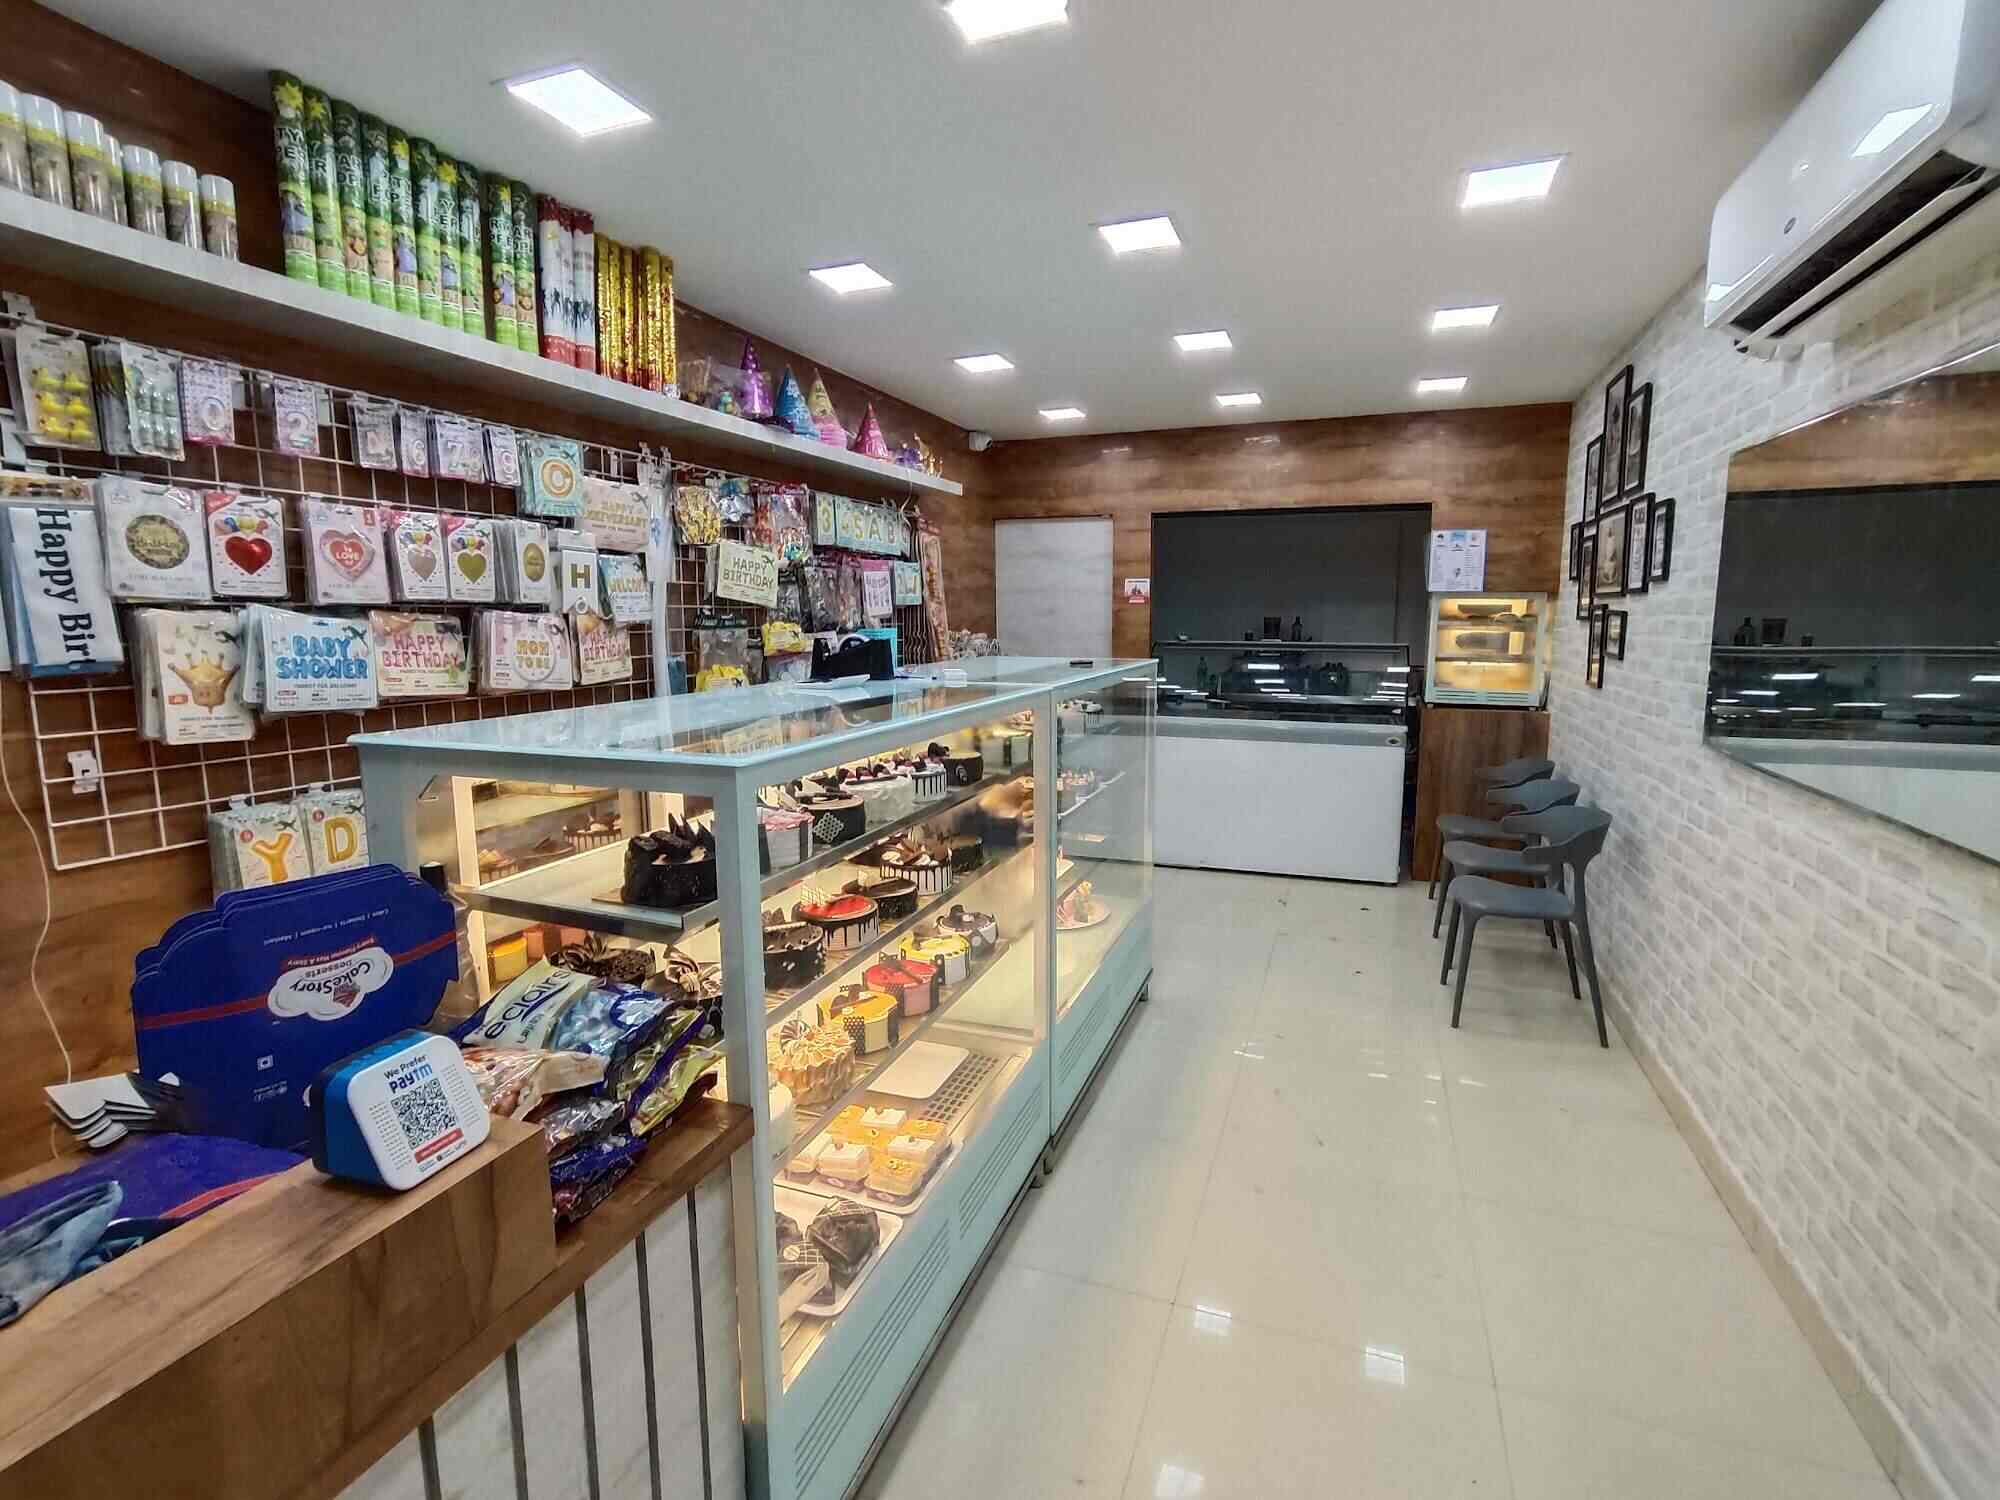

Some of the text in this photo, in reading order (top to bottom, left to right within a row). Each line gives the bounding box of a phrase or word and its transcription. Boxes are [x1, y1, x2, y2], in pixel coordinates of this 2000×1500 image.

[34, 508, 79, 604] Happy
[733, 557, 769, 575] HAPPY
[570, 563, 592, 589] H
[723, 568, 775, 589] BIRTHDAY
[292, 635, 353, 658] BABY
[393, 632, 447, 651] HAPPY
[276, 656, 369, 680] SHOWER
[382, 649, 460, 669] BIRTHDAY
[324, 815, 358, 865] D
[289, 962, 371, 994] CakeStory
[305, 960, 353, 978] Desserts
[484, 970, 571, 1040] eclairs
[384, 1055, 427, 1080] We Prefer
